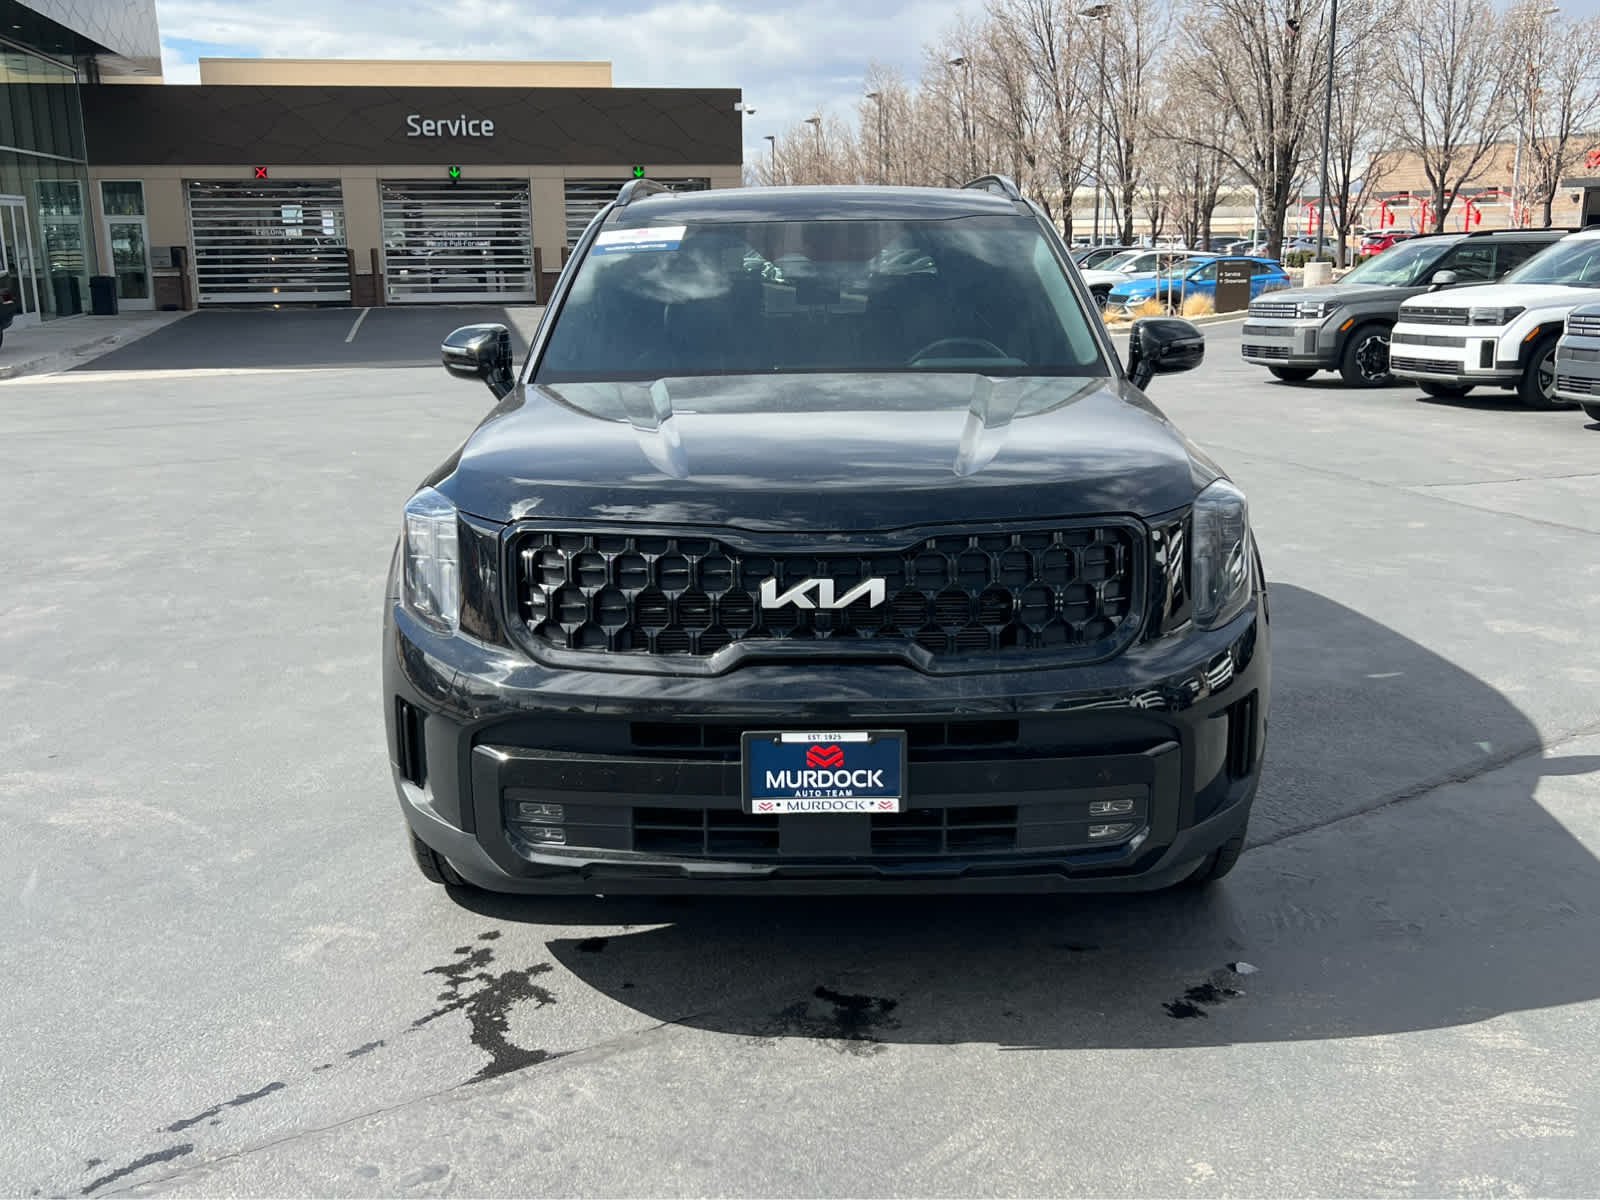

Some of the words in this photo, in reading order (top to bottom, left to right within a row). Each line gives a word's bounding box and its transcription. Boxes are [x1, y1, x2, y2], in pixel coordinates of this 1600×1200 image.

[407, 114, 494, 136] Service
[761, 578, 885, 608] KIA
[766, 770, 884, 788] MURDOCK
[795, 789, 822, 797] AUTO
[787, 800, 865, 810] MURDOCK
